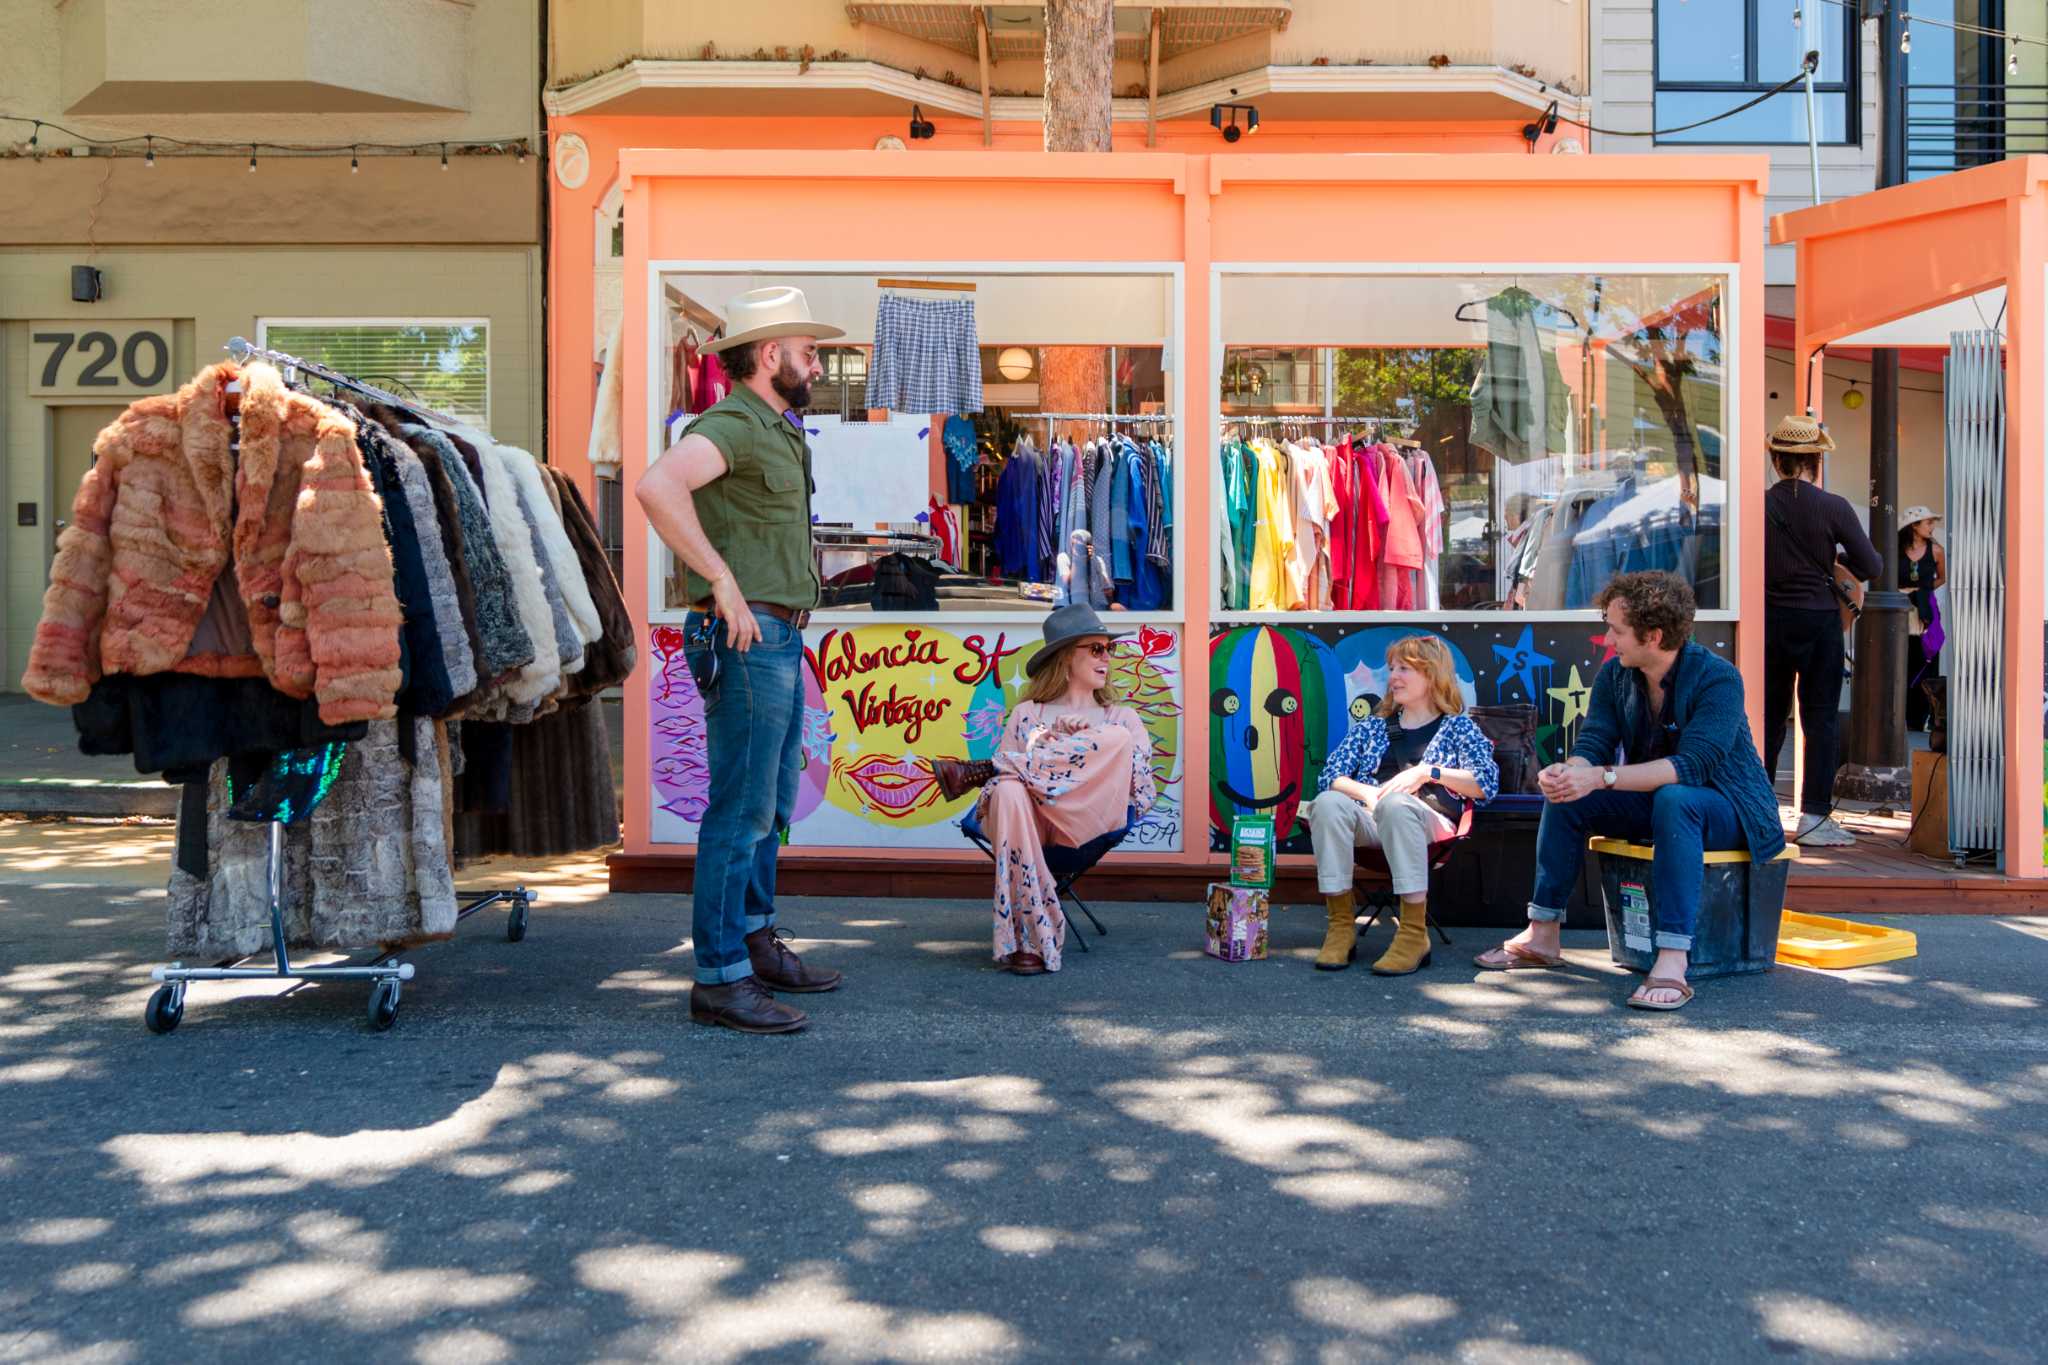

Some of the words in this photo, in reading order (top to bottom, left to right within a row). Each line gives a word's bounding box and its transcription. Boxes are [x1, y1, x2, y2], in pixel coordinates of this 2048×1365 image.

[33, 331, 169, 387] 720
[803, 628, 949, 693] Valencia
[953, 632, 1023, 689] St
